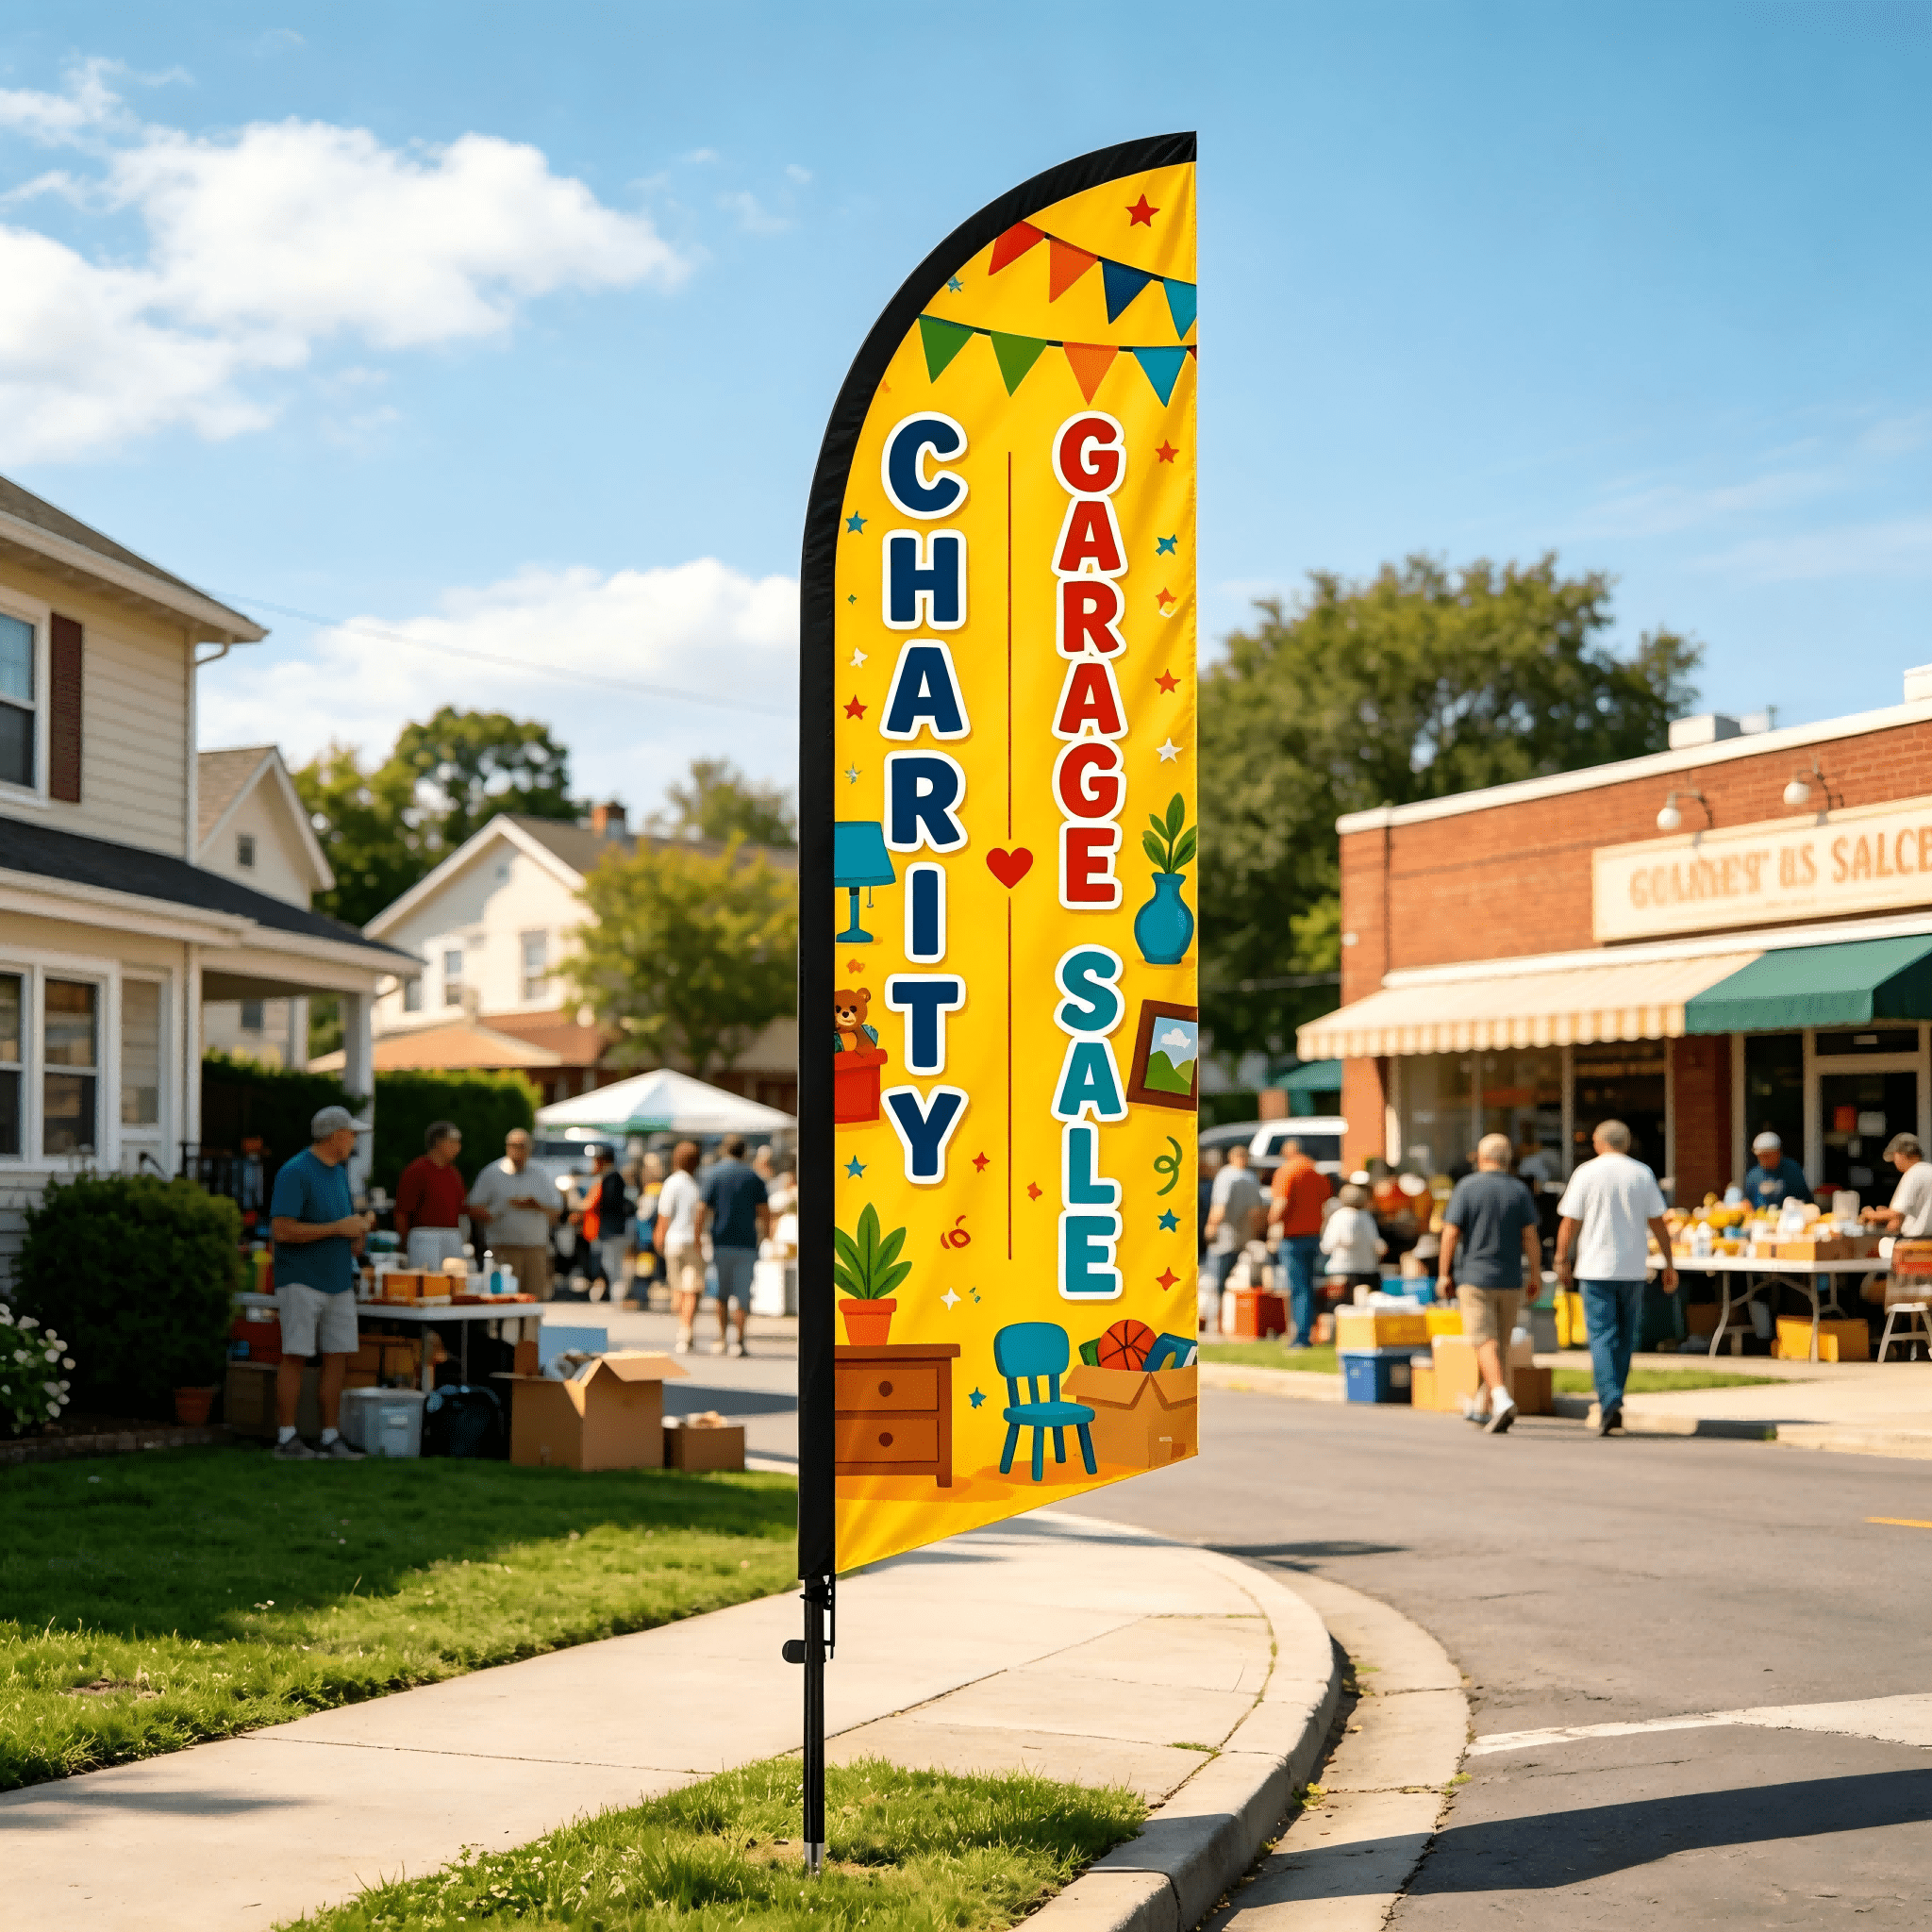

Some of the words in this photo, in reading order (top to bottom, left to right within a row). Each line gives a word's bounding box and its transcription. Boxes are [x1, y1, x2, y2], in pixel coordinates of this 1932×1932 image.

[883, 415, 966, 1180] CHARITY
[1055, 413, 1125, 907] GARAGE
[1055, 947, 1125, 1296] SALE
